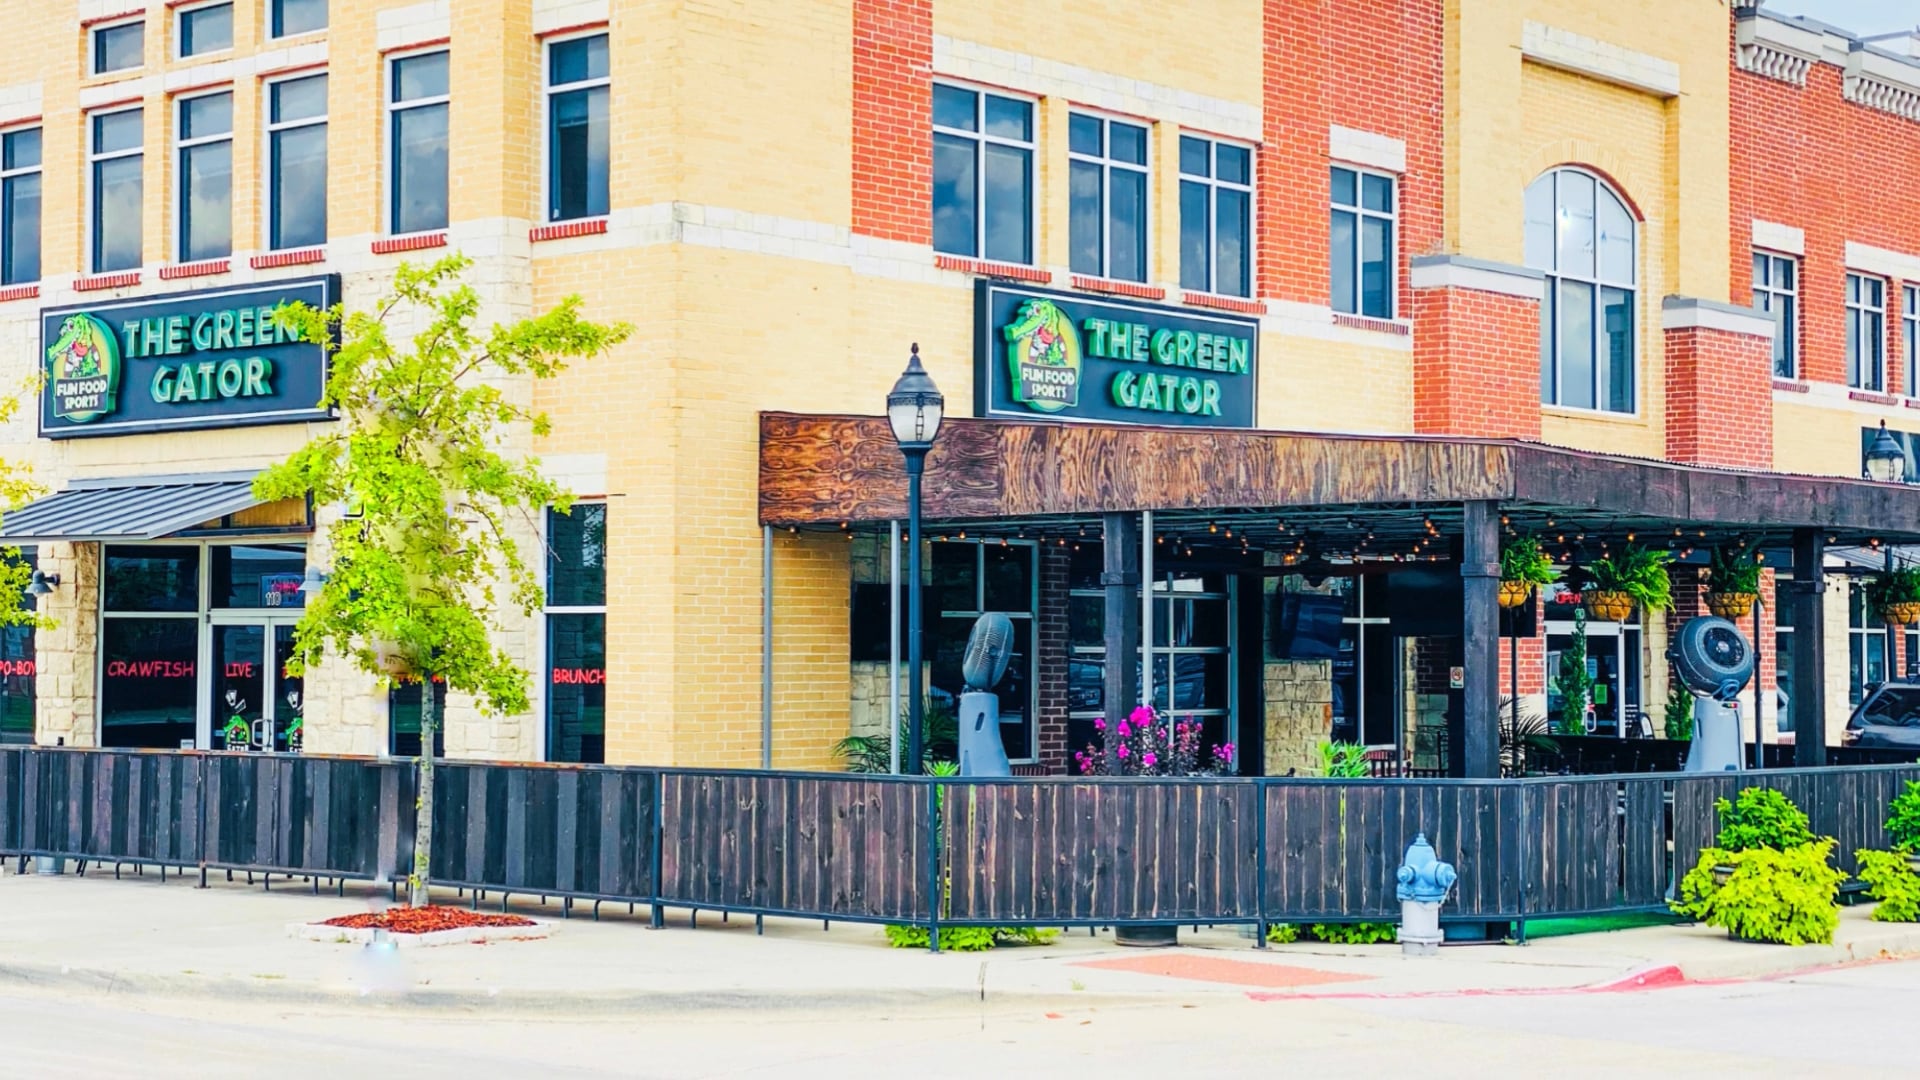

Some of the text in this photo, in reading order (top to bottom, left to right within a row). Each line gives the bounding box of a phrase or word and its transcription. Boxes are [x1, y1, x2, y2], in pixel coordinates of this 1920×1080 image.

[122, 315, 190, 358] THE
[1084, 317, 1249, 374] THE GREEN
[150, 356, 273, 404] GATOR
[1022, 367, 1075, 386] FUN FOOD
[56, 379, 107, 397] FUN FOOD
[1031, 383, 1067, 399] SPORTS
[1111, 369, 1222, 416] GATOR
[65, 394, 99, 410] SPORTS
[1555, 591, 1582, 605] OPEN
[107, 660, 195, 678] CRAWFISH
[225, 662, 253, 678] LIVE
[553, 667, 607, 684] BRUNCH
